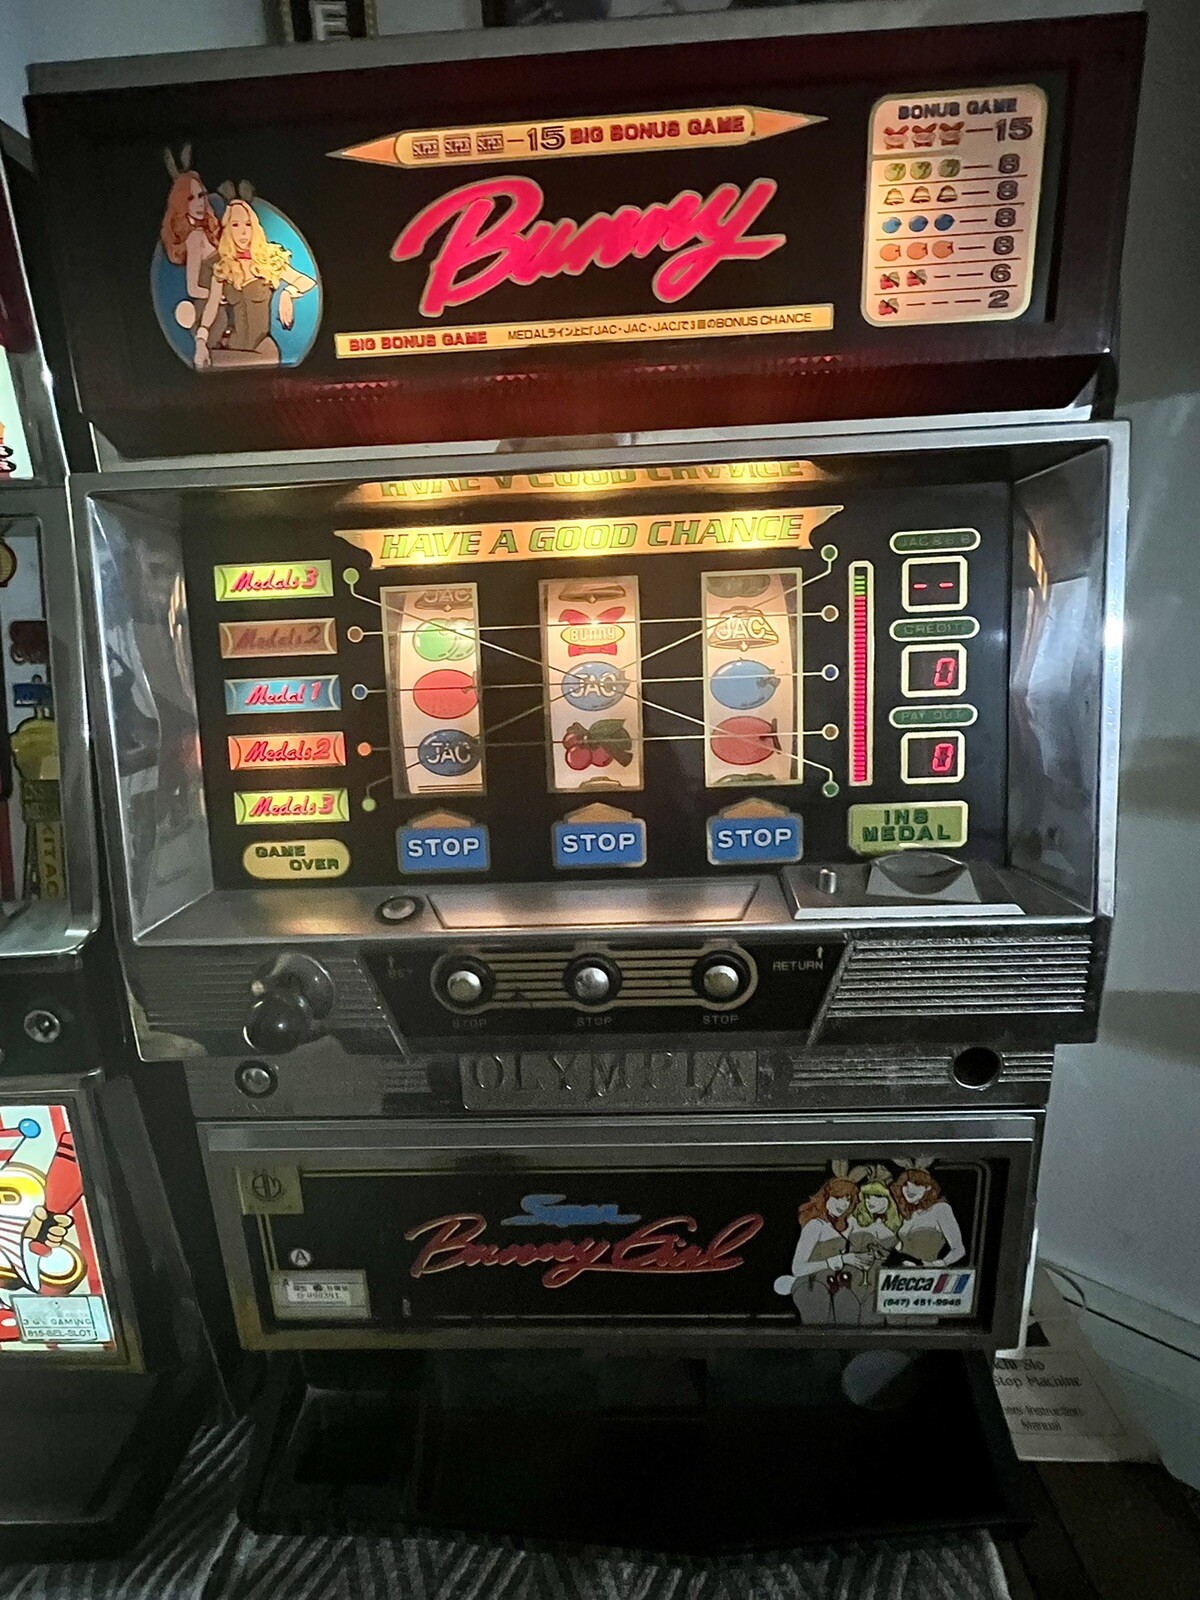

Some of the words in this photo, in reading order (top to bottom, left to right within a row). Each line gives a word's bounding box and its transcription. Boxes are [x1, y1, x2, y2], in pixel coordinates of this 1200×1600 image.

[898, 101, 960, 120] BONUS
[967, 98, 1018, 116] GAME
[527, 126, 565, 151] 15
[570, 126, 603, 145] BIG
[610, 121, 680, 143] BONUS
[687, 115, 745, 136] GAME
[994, 116, 1033, 143] 15
[390, 176, 787, 318] Bunny
[990, 263, 1012, 283] 6
[987, 289, 1010, 309] 2
[759, 311, 812, 327] CHANCE
[349, 338, 375, 353] BIG
[380, 334, 437, 350] BONUS
[441, 330, 488, 347] GAME
[380, 530, 482, 560] HAVE
[488, 528, 516, 554] A
[527, 521, 639, 553] GOOD
[646, 513, 804, 547] CHANCE
[231, 569, 301, 592] Medals
[304, 566, 319, 587] 3
[305, 625, 322, 645] 2
[716, 616, 766, 641] JAC
[933, 657, 956, 688] 0
[244, 685, 305, 706] Medal
[309, 682, 321, 701] 1
[569, 671, 617, 697] JAC
[244, 741, 313, 764] Medals
[312, 738, 331, 759] 2
[425, 741, 472, 764] JAC
[931, 742, 955, 773] 0
[249, 796, 316, 818] Medals
[318, 793, 335, 813] 3
[884, 808, 929, 826] INS
[717, 828, 792, 849] STOP
[862, 823, 952, 843] MEDAL
[255, 845, 306, 859] GAME
[408, 837, 480, 858] STOP
[562, 834, 635, 854] STOP
[289, 857, 340, 872] OVER
[772, 958, 825, 972] RETURN
[452, 1017, 488, 1030] STOP
[576, 1015, 613, 1027] STOP
[702, 1013, 739, 1025] STOP
[474, 1051, 751, 1097] OLYMPIA
[404, 1212, 610, 1289] Bunny
[611, 1212, 765, 1274] Girl
[881, 1274, 935, 1292] Mecca
[50, 1318, 92, 1327] GAMING
